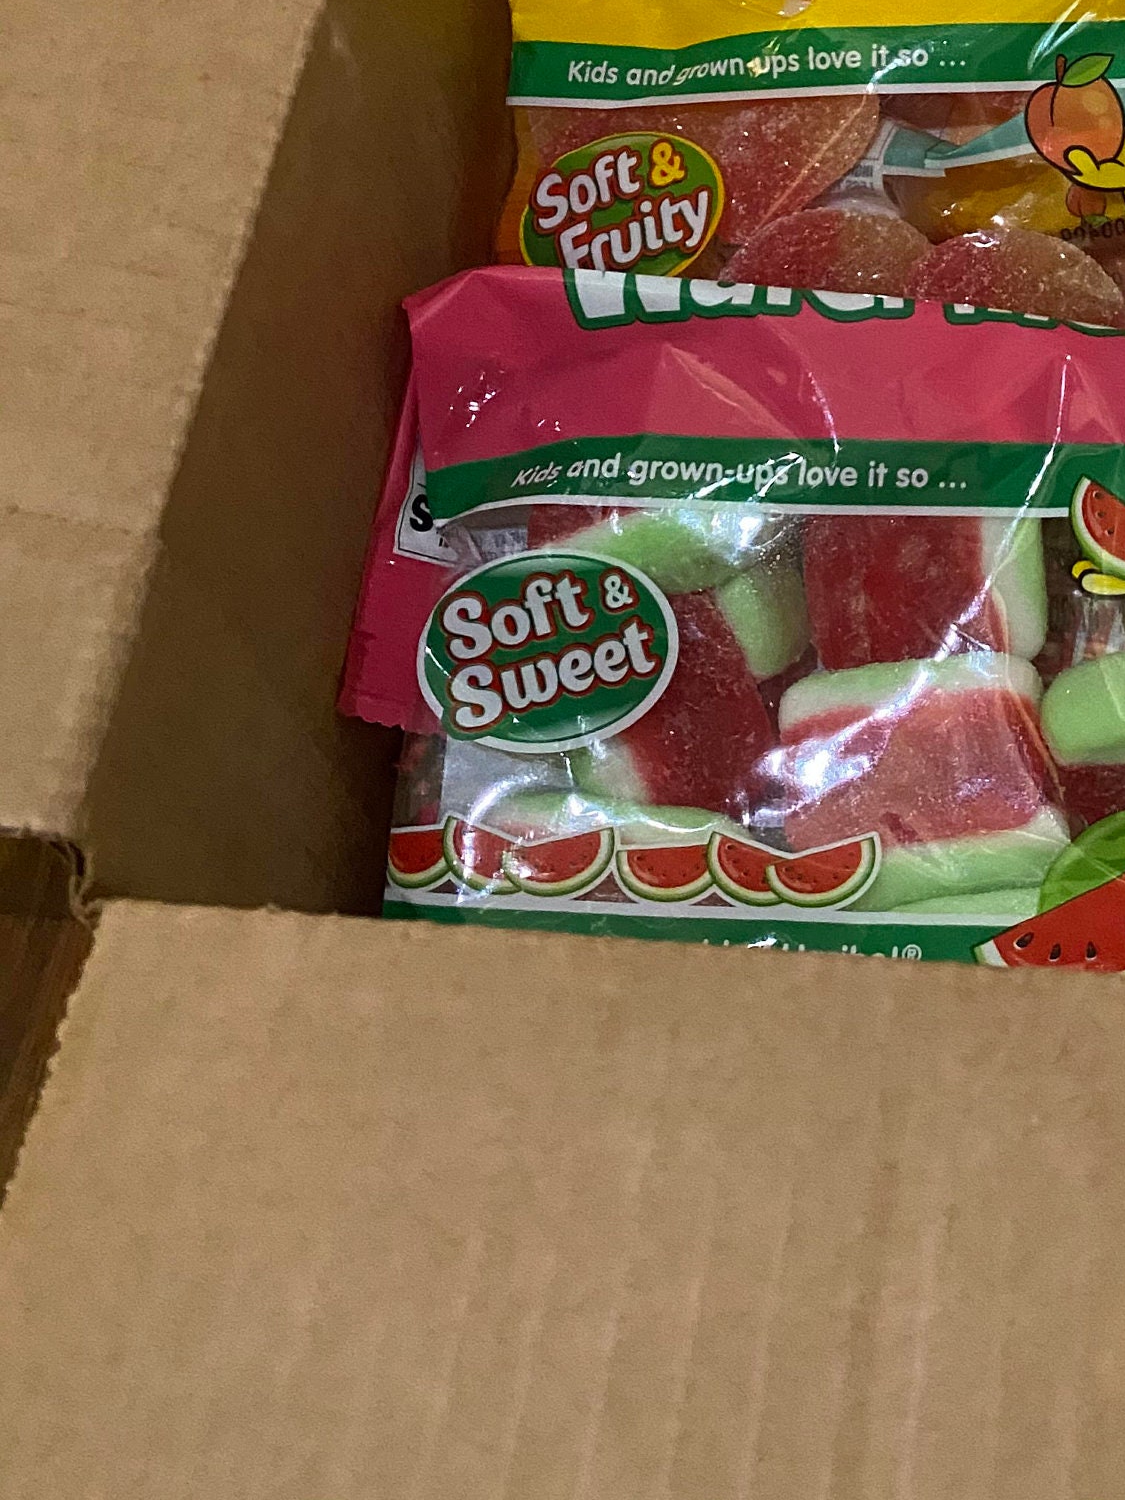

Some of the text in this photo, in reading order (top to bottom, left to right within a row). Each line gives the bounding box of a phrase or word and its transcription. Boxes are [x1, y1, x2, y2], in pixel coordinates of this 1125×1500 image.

[567, 59, 618, 84] Kids
[626, 65, 674, 86] and
[672, 52, 800, 86] grownups
[807, 46, 862, 71] love
[870, 43, 889, 68] it
[897, 48, 928, 68] so
[534, 139, 688, 231] Soft &
[557, 187, 709, 272] Fruity
[510, 460, 563, 488] Kids
[566, 452, 622, 479] and
[628, 457, 789, 492] grown-ups
[798, 455, 858, 487] love
[868, 459, 889, 487] it
[895, 465, 930, 488] so
[441, 570, 634, 661] Soft &
[449, 620, 658, 730] Sweet
